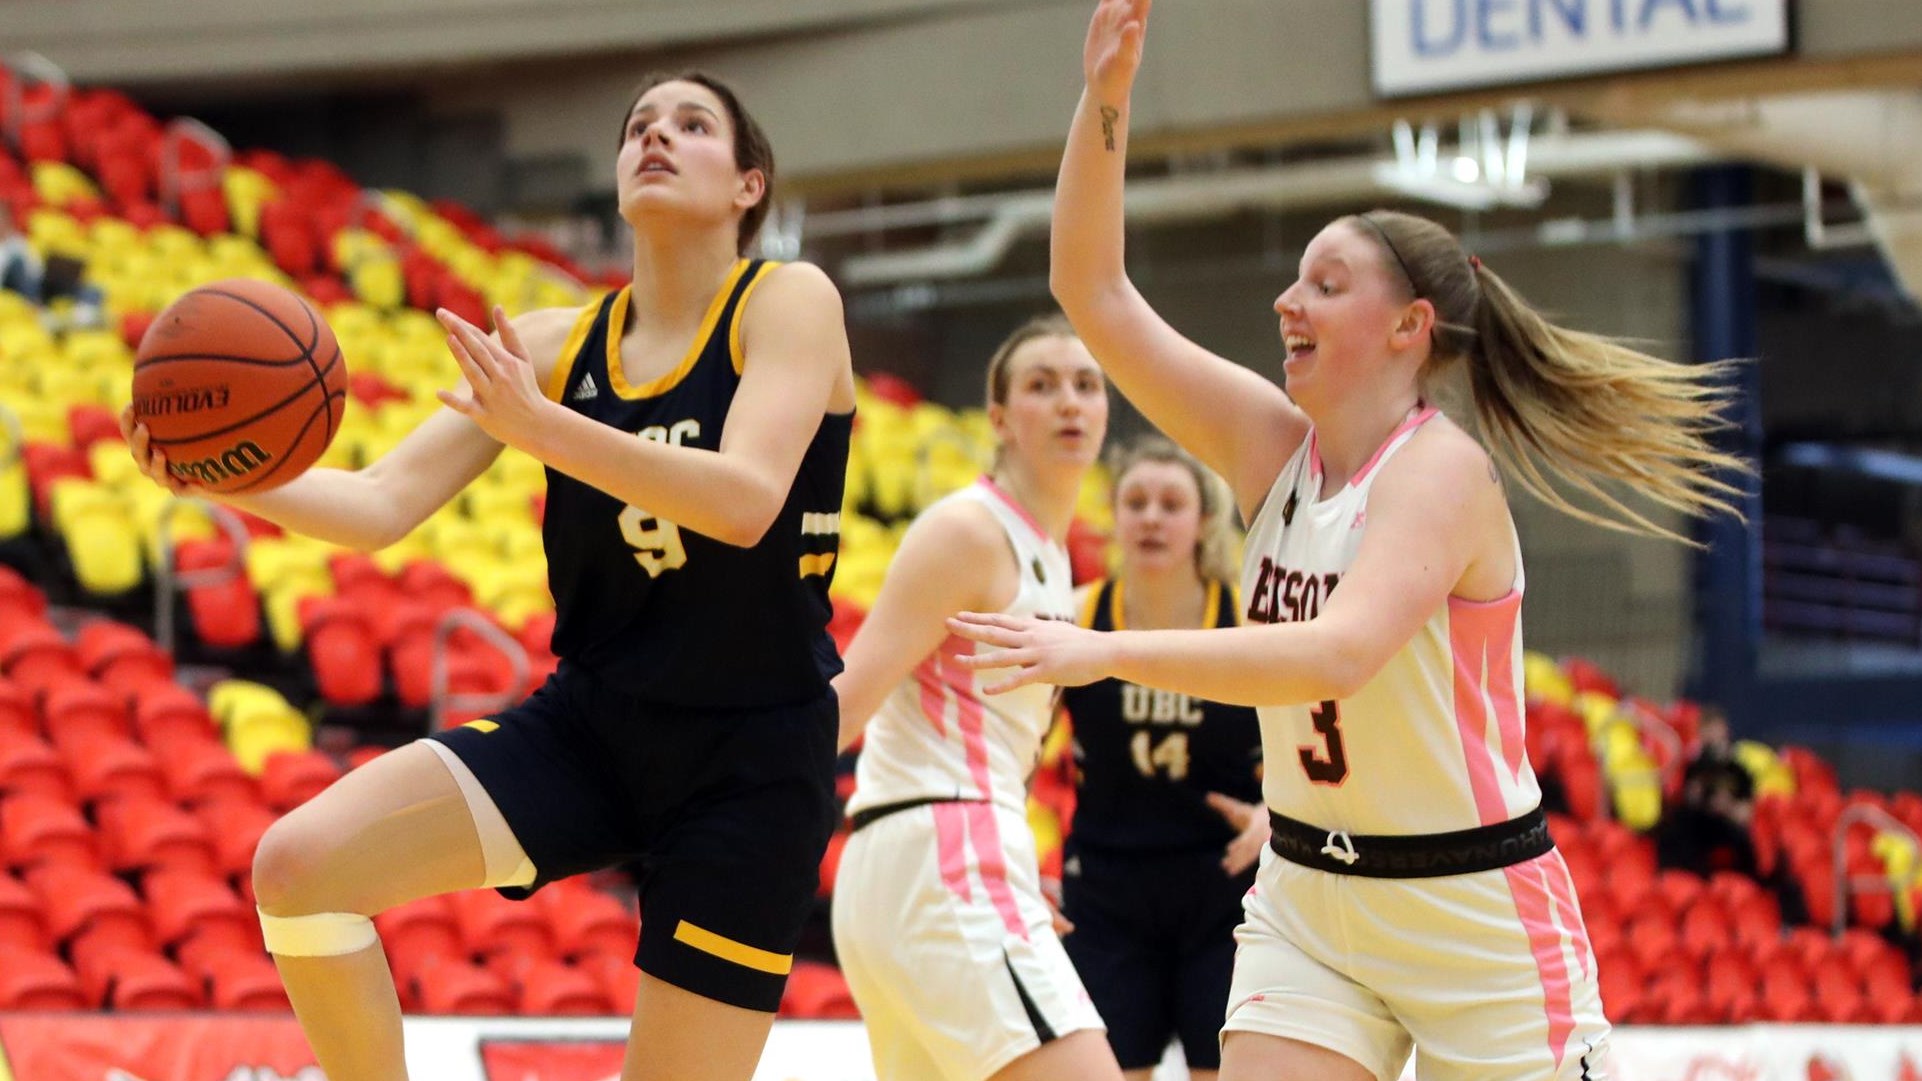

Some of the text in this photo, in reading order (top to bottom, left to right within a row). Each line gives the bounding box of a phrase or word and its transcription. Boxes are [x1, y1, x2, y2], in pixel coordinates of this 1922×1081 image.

[618, 503, 687, 580] 9
[1122, 683, 1204, 726] UBC
[1131, 729, 1190, 781] 14
[1298, 699, 1349, 787] 3
